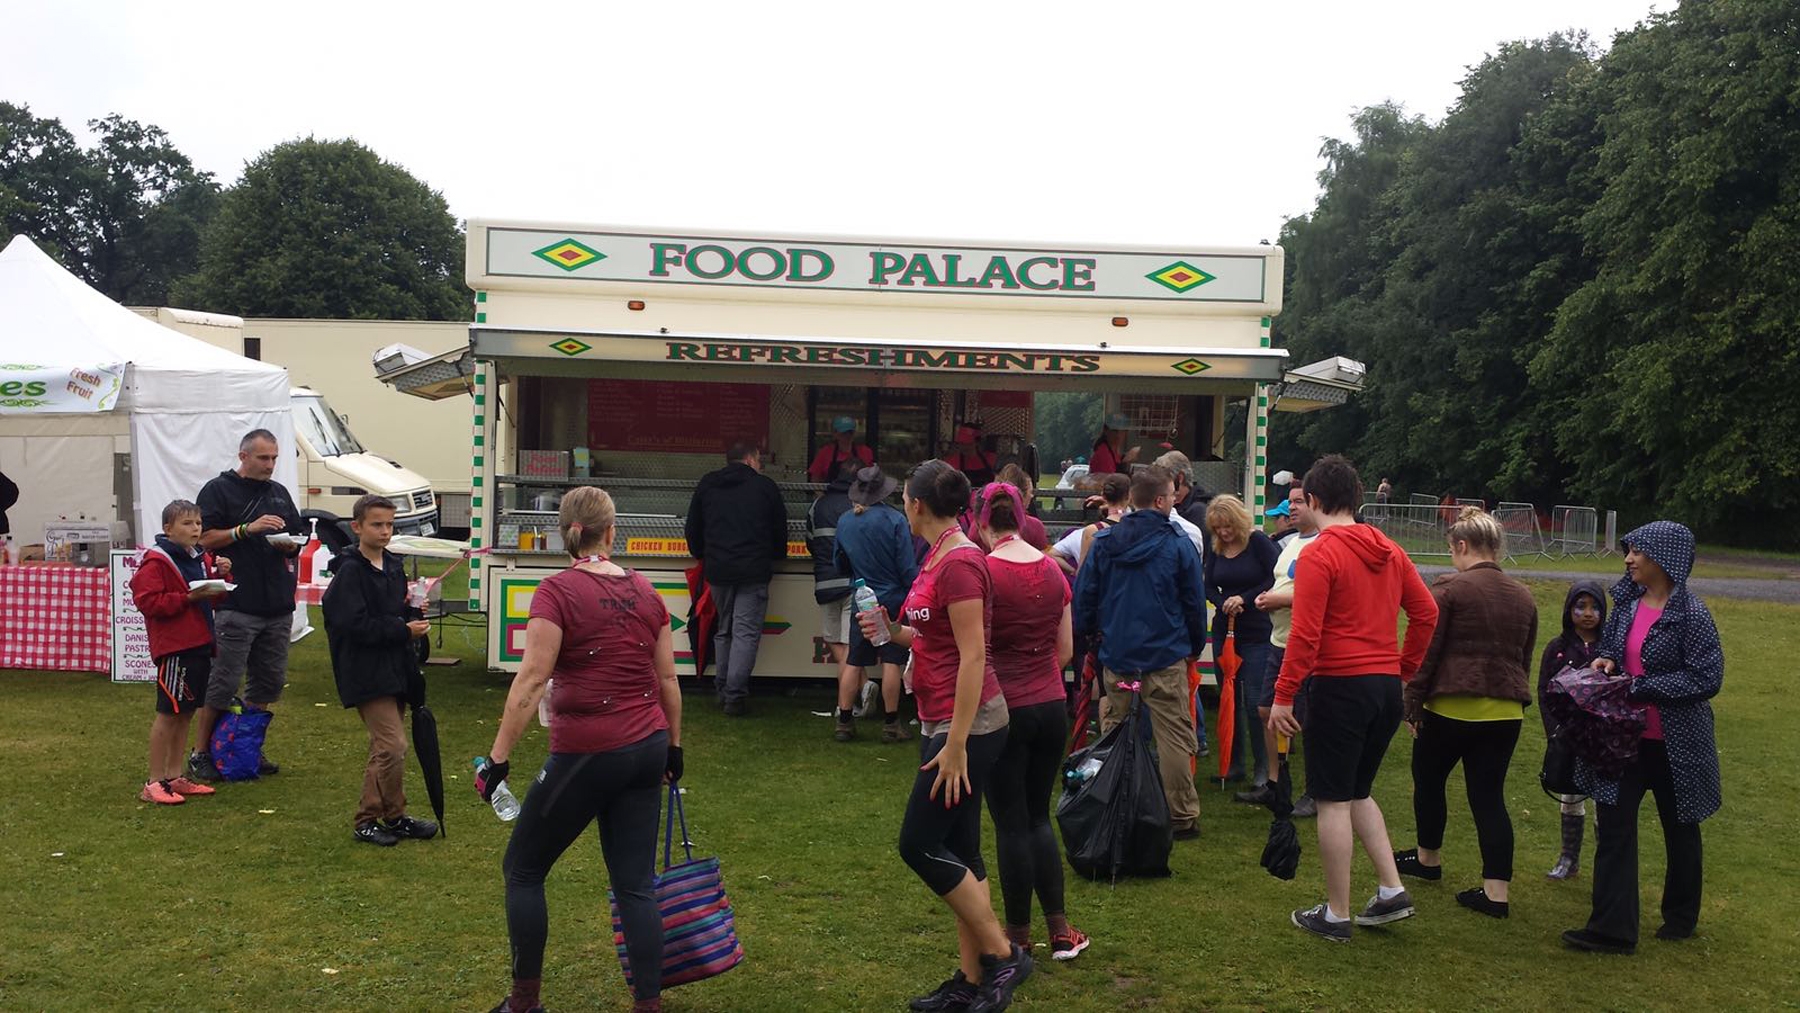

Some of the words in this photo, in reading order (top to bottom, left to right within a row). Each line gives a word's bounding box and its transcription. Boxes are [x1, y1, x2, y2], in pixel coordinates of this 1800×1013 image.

[649, 242, 835, 282] FOOD
[868, 251, 1097, 291] PALACE
[665, 341, 1101, 372] REFRESHMENTS
[70, 366, 102, 388] Fresh
[66, 380, 94, 400] Fruit
[630, 541, 663, 551] CHICKEN
[667, 542, 688, 552] BURG
[115, 616, 145, 625] CROISS
[125, 633, 149, 642] DANIS
[125, 644, 150, 653] PASTR
